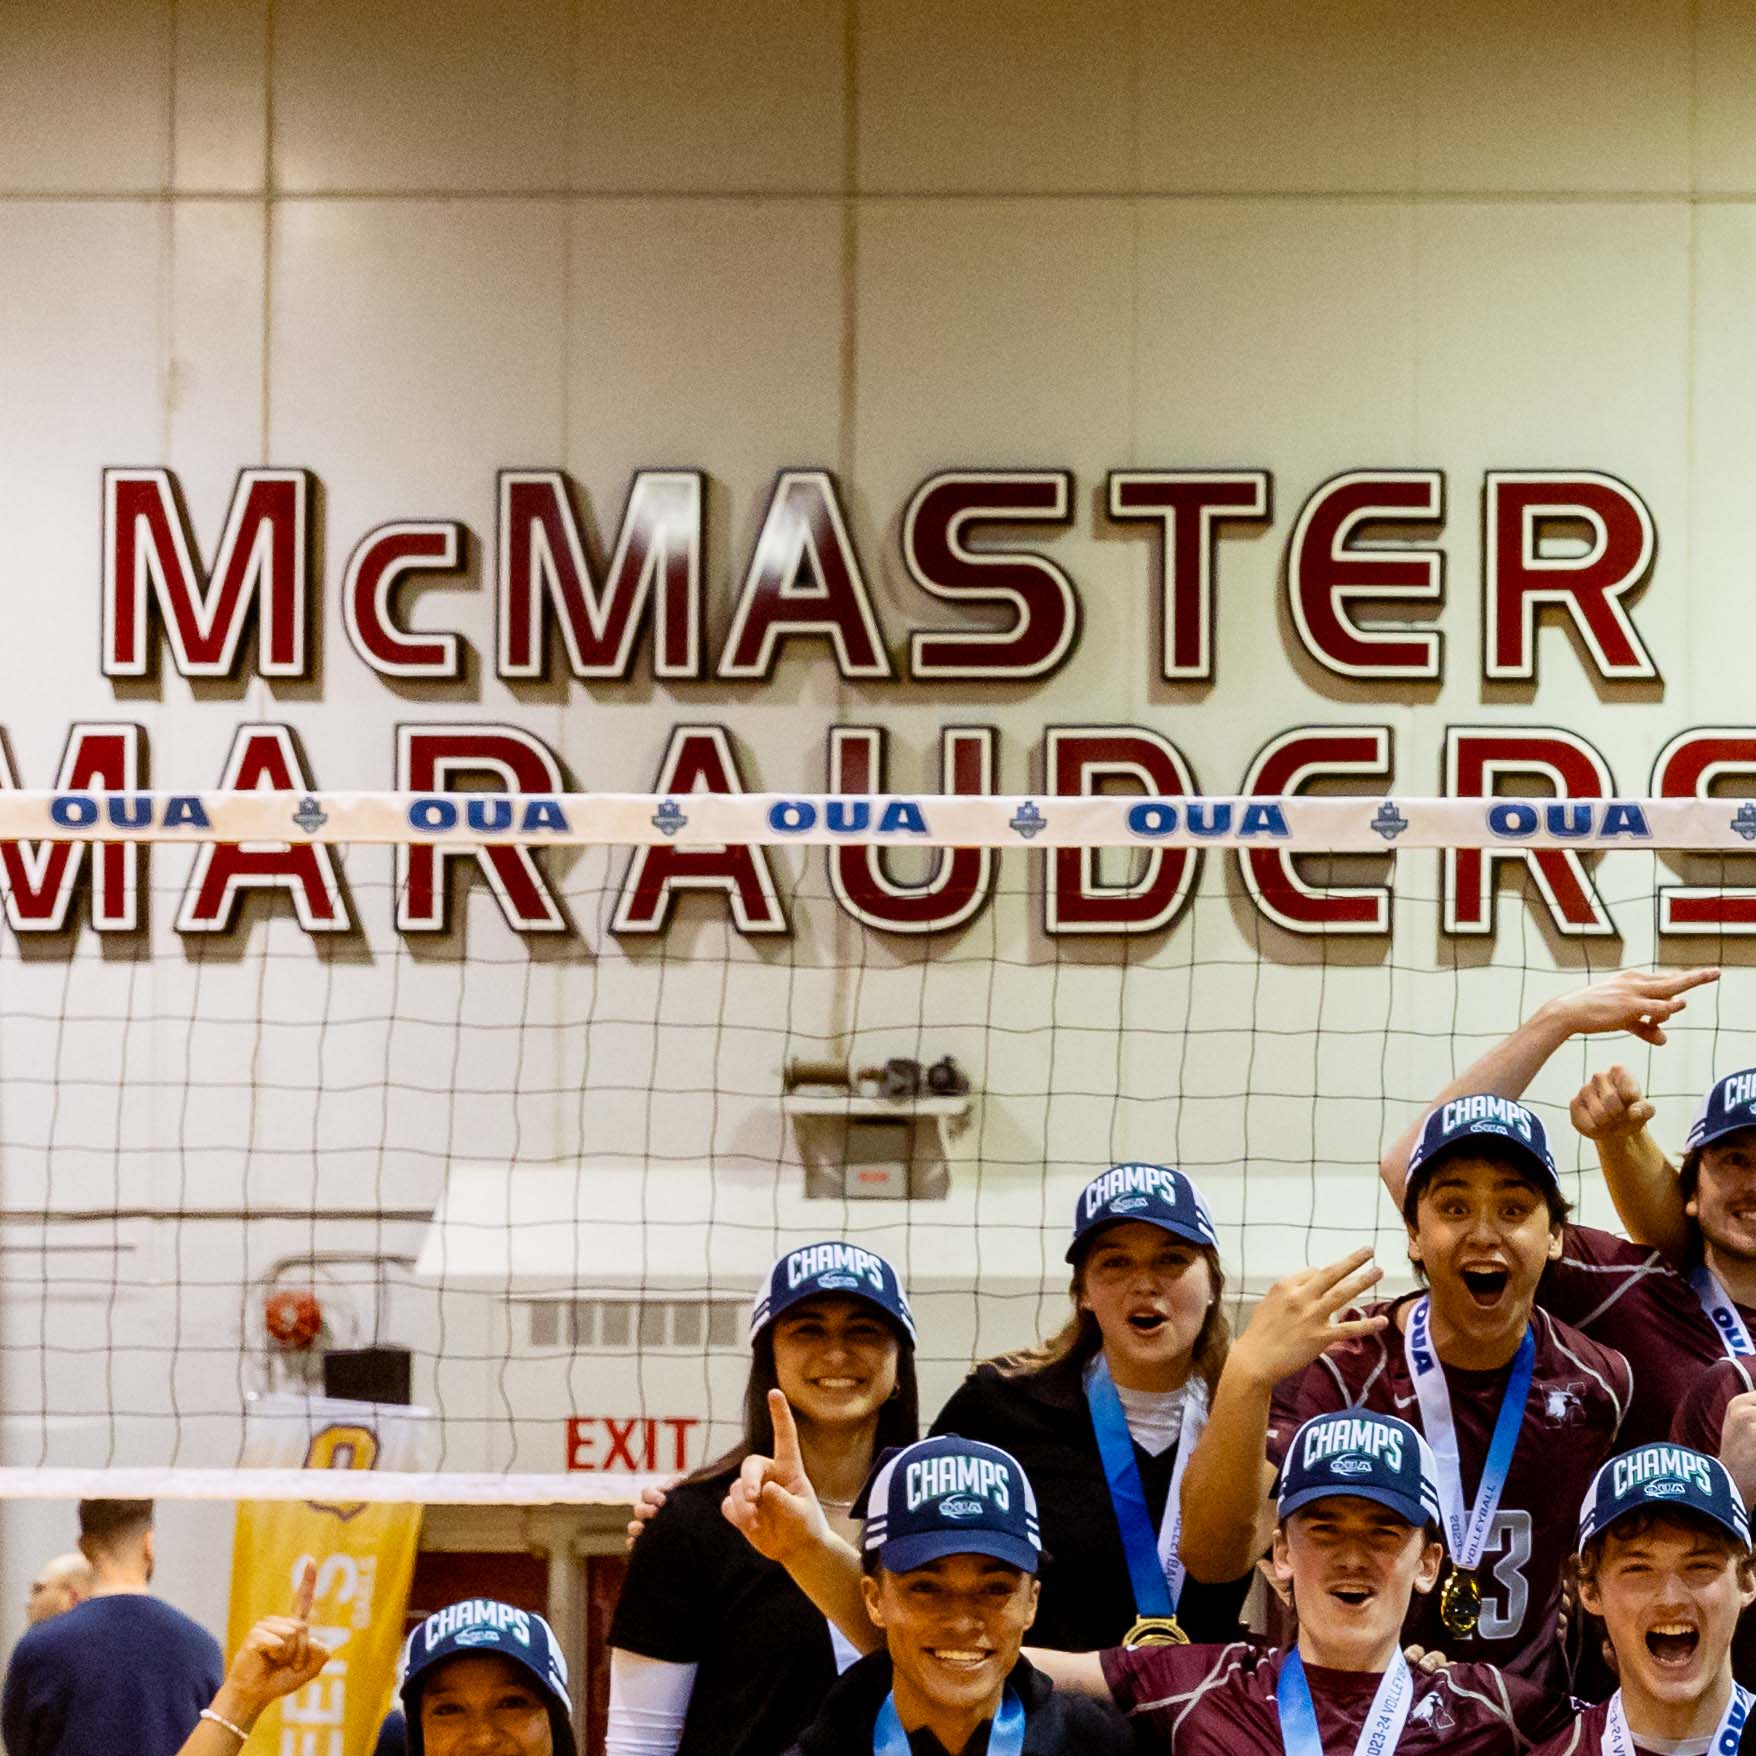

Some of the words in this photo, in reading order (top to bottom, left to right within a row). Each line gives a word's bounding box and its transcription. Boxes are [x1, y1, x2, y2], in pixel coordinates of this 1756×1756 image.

[101, 467, 1661, 682] McMASTER
[49, 795, 213, 832] OUA
[406, 796, 574, 835] OUA
[766, 797, 931, 836] OUA
[1126, 801, 1294, 840] OUA
[1484, 801, 1653, 840] OUA
[1441, 1094, 1534, 1140] CHAMPS
[1085, 1164, 1177, 1219] CHAMPS
[788, 1242, 884, 1291] CHAMPS
[1413, 1302, 1437, 1378] OUA
[566, 1416, 698, 1472] EXIT
[1302, 1419, 1404, 1472] CHAMPS
[905, 1453, 1012, 1514] CHAMPS
[1612, 1448, 1714, 1500] CHAMPS
[1465, 1482, 1497, 1566] VOLLEYBALL
[1462, 1507, 1533, 1641] 3
[424, 1598, 532, 1653] CHAMPS
